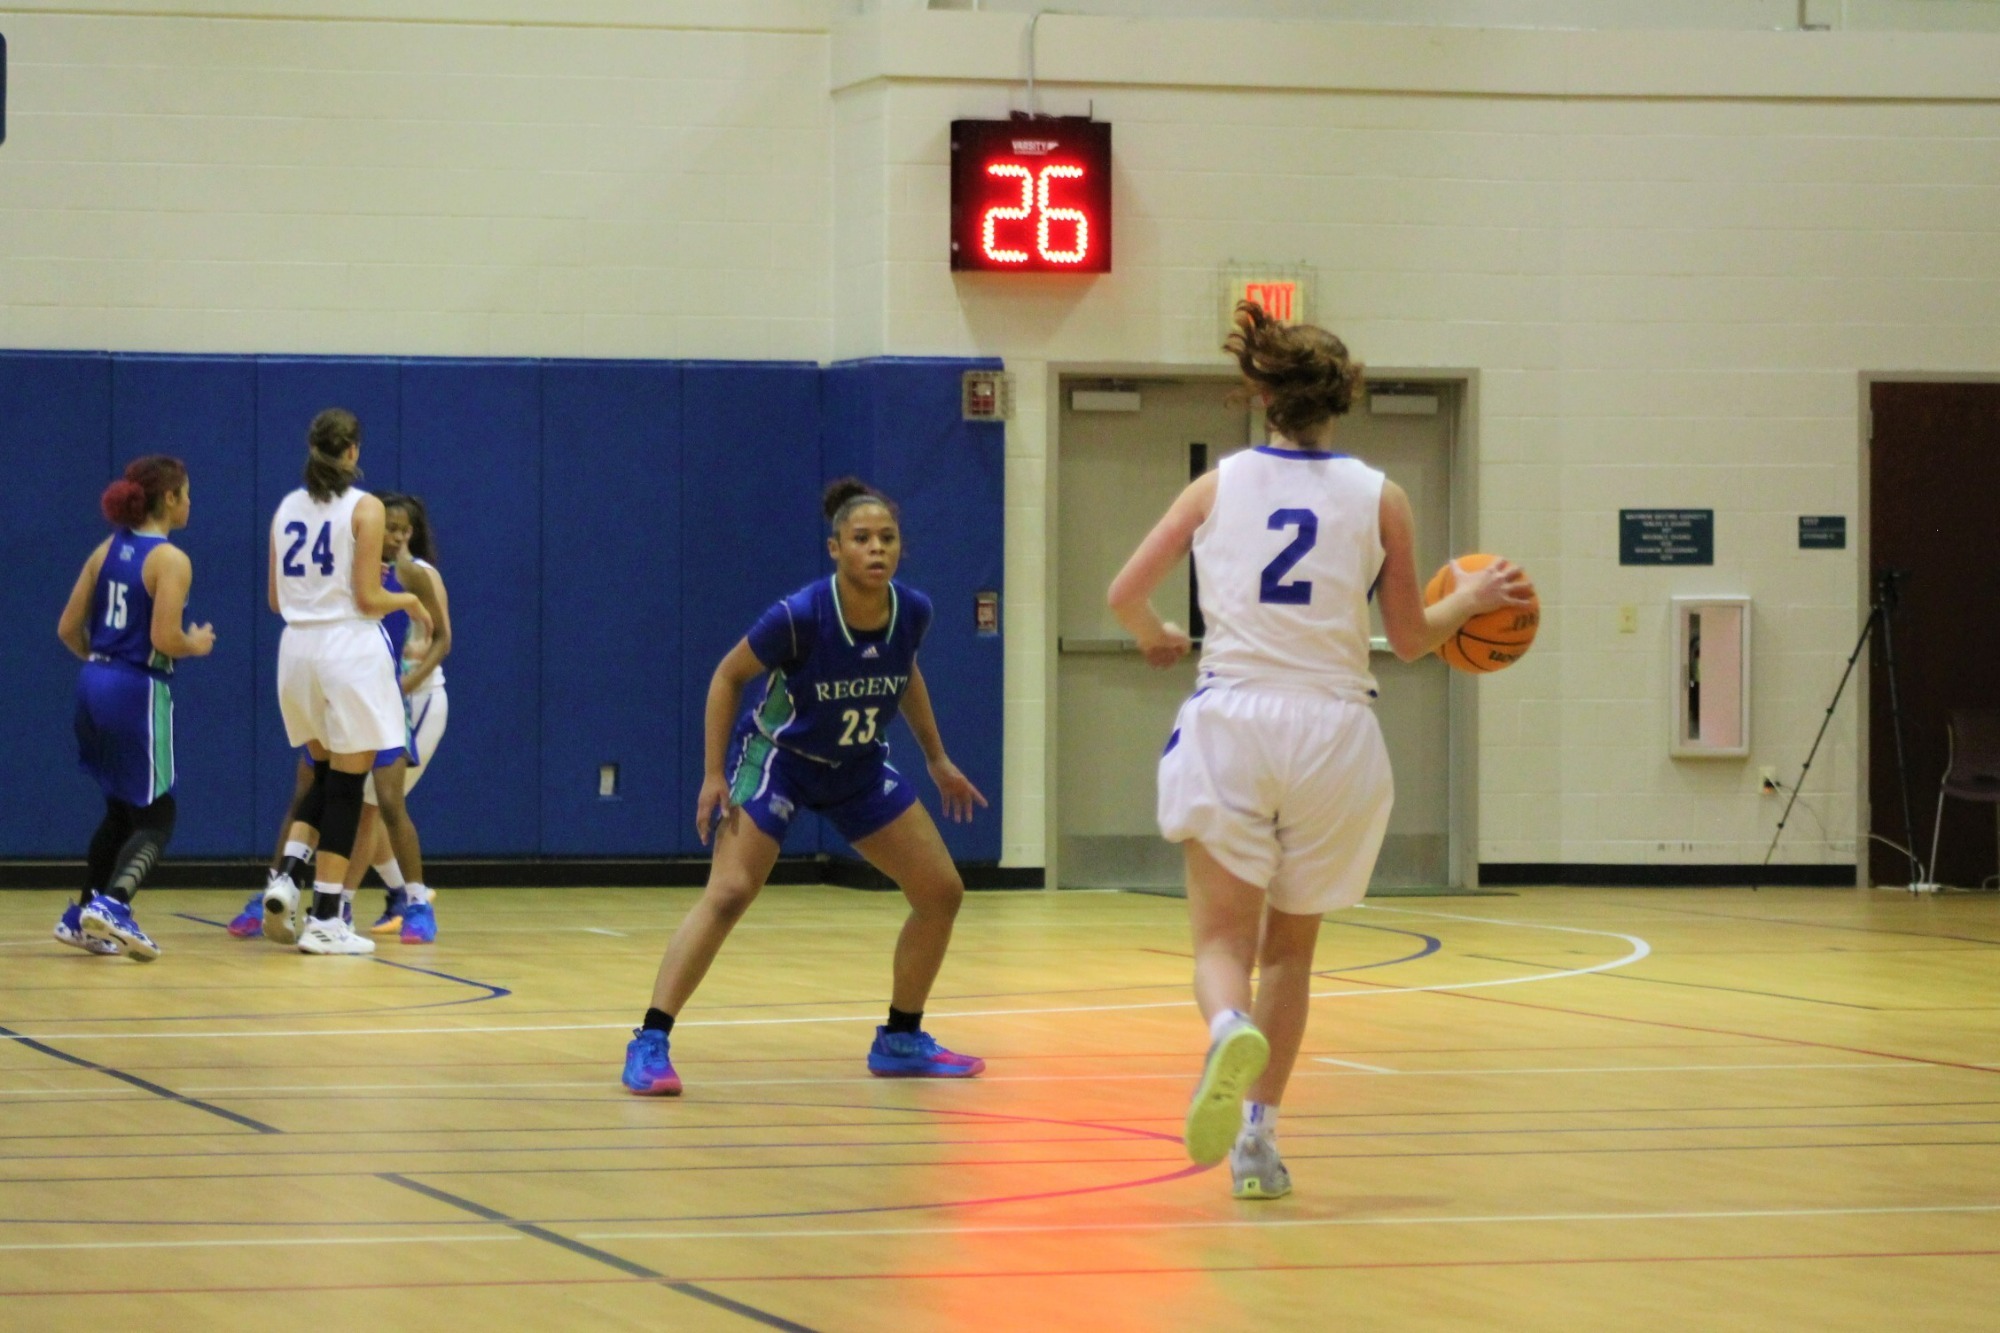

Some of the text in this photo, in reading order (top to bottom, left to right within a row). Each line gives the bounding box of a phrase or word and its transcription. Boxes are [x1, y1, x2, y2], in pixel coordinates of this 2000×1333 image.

[983, 164, 1088, 263] 26
[283, 521, 334, 577] 24
[1259, 508, 1319, 605] 2
[106, 580, 129, 630] 15
[838, 707, 880, 746] 23
